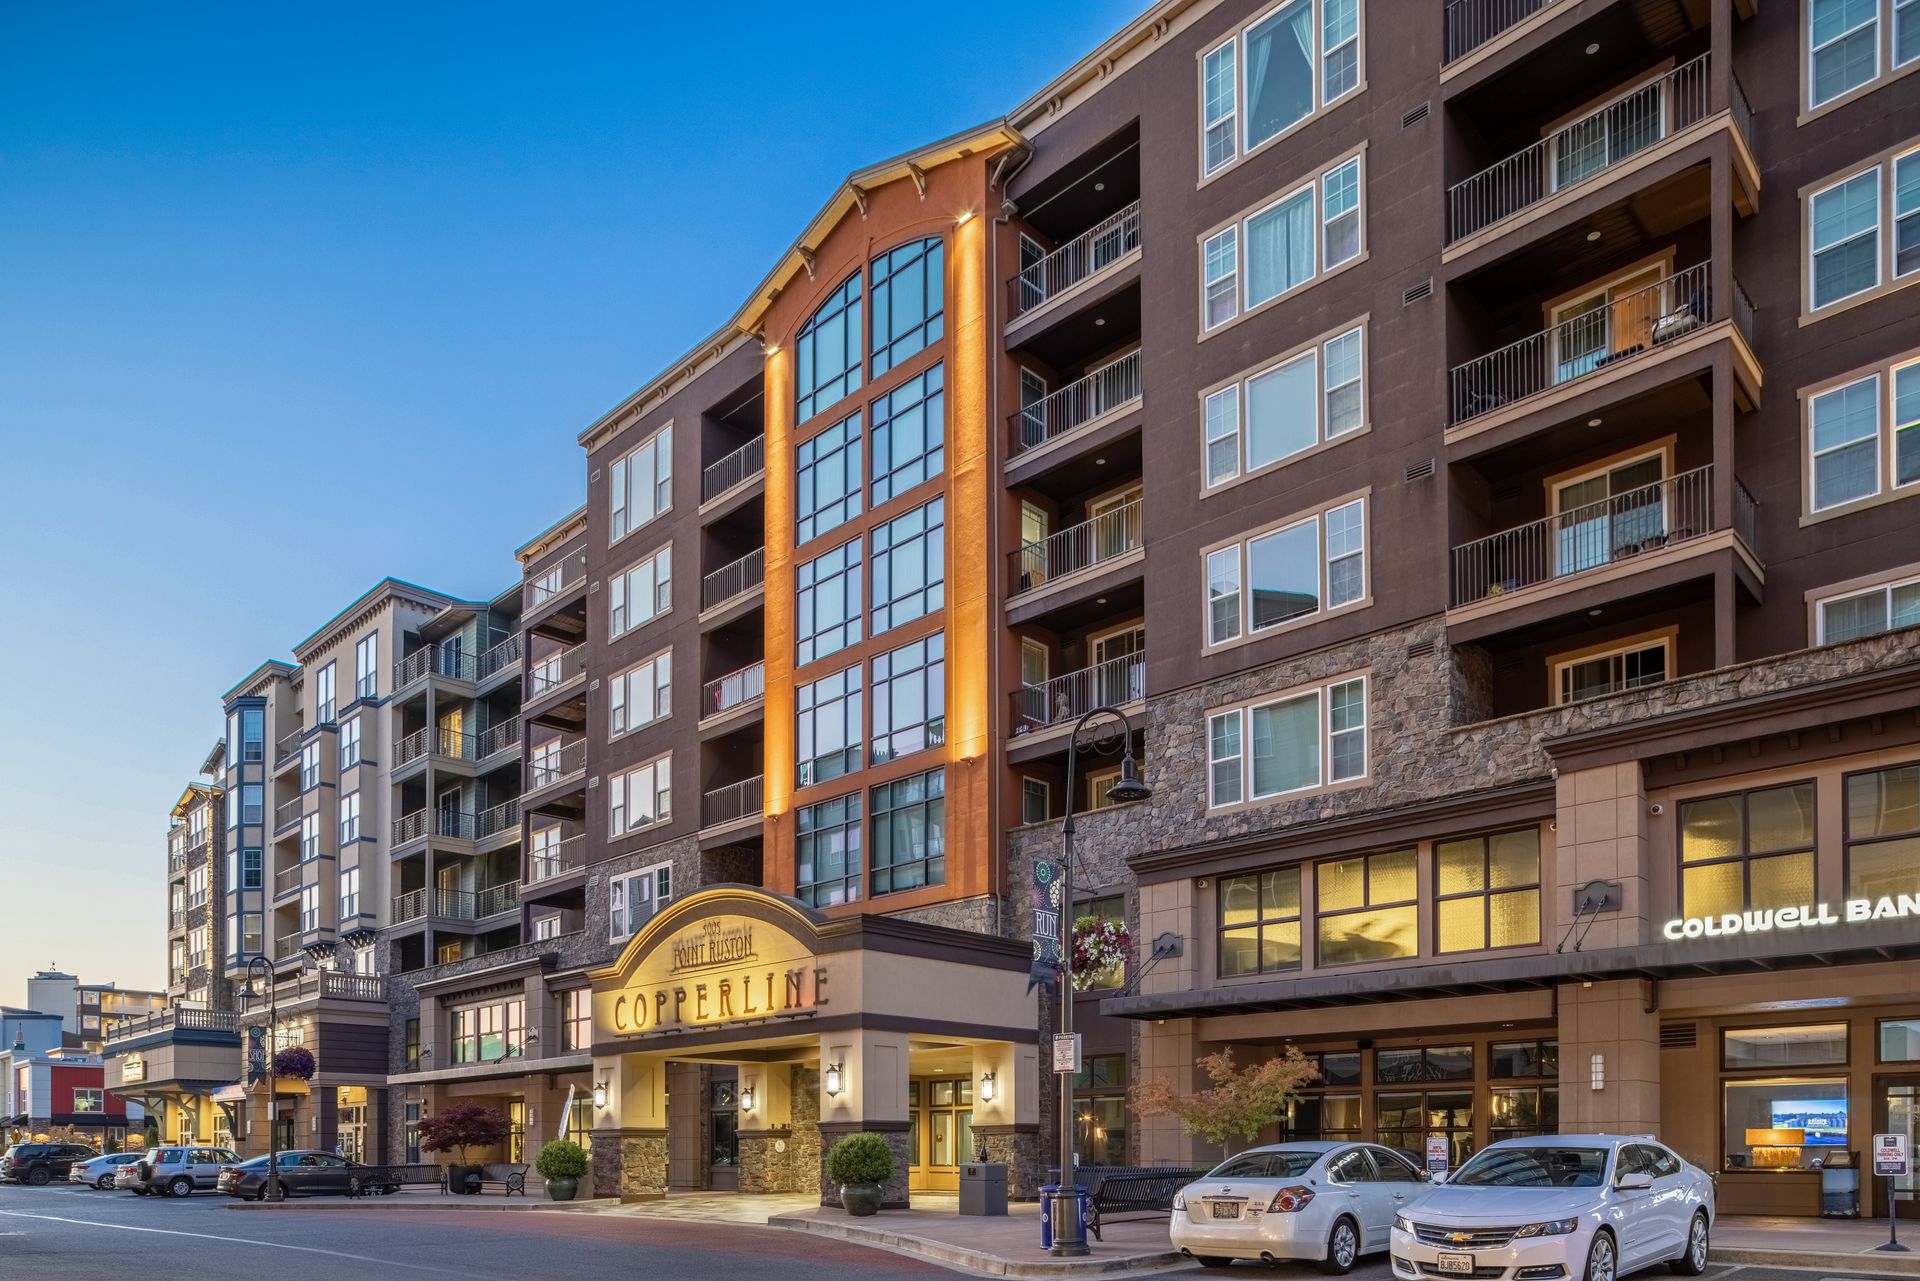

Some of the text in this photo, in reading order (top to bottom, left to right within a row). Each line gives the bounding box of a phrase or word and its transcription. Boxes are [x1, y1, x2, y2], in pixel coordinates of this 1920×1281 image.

[1036, 911, 1057, 937] RUN
[673, 934, 753, 970] POINT RUSTON
[615, 967, 830, 1030] COPPERLINE
